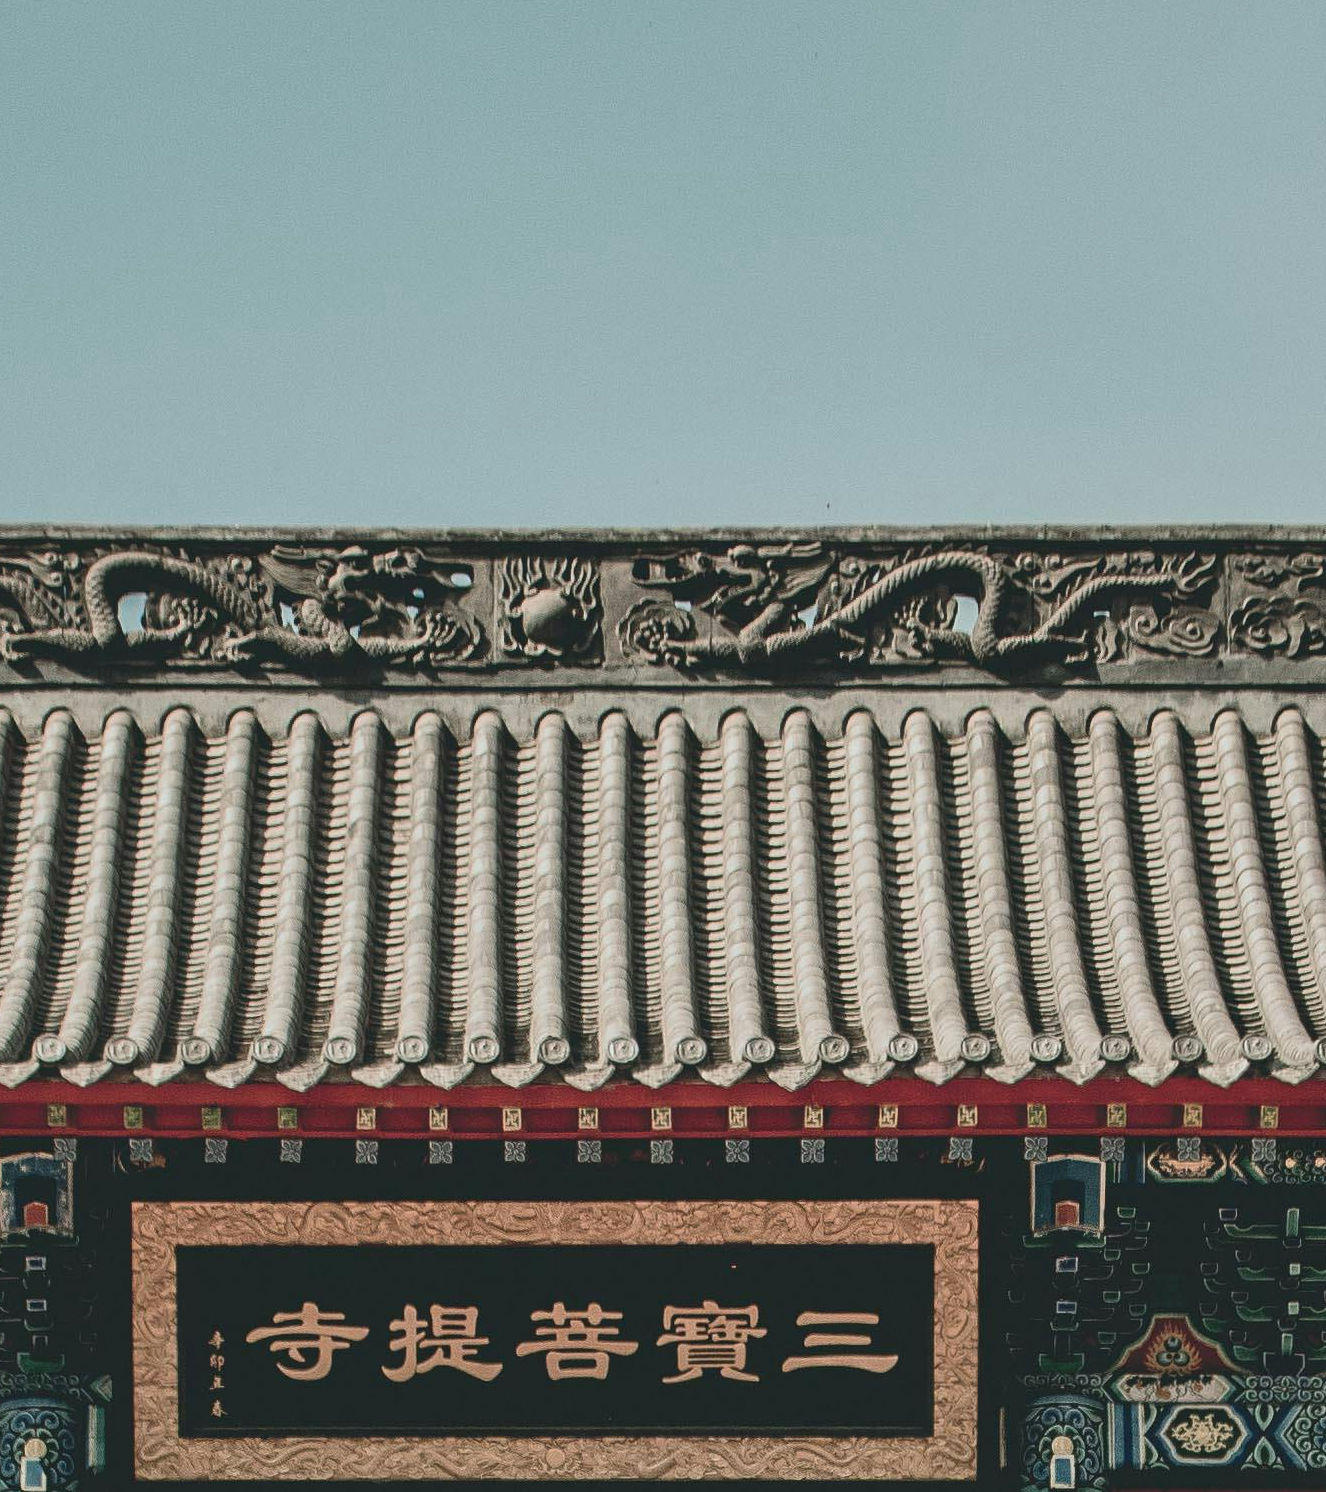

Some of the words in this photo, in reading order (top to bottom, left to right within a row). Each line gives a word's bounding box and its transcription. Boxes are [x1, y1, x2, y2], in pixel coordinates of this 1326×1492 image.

[245, 1300, 899, 1384] 三寶菩提寺
